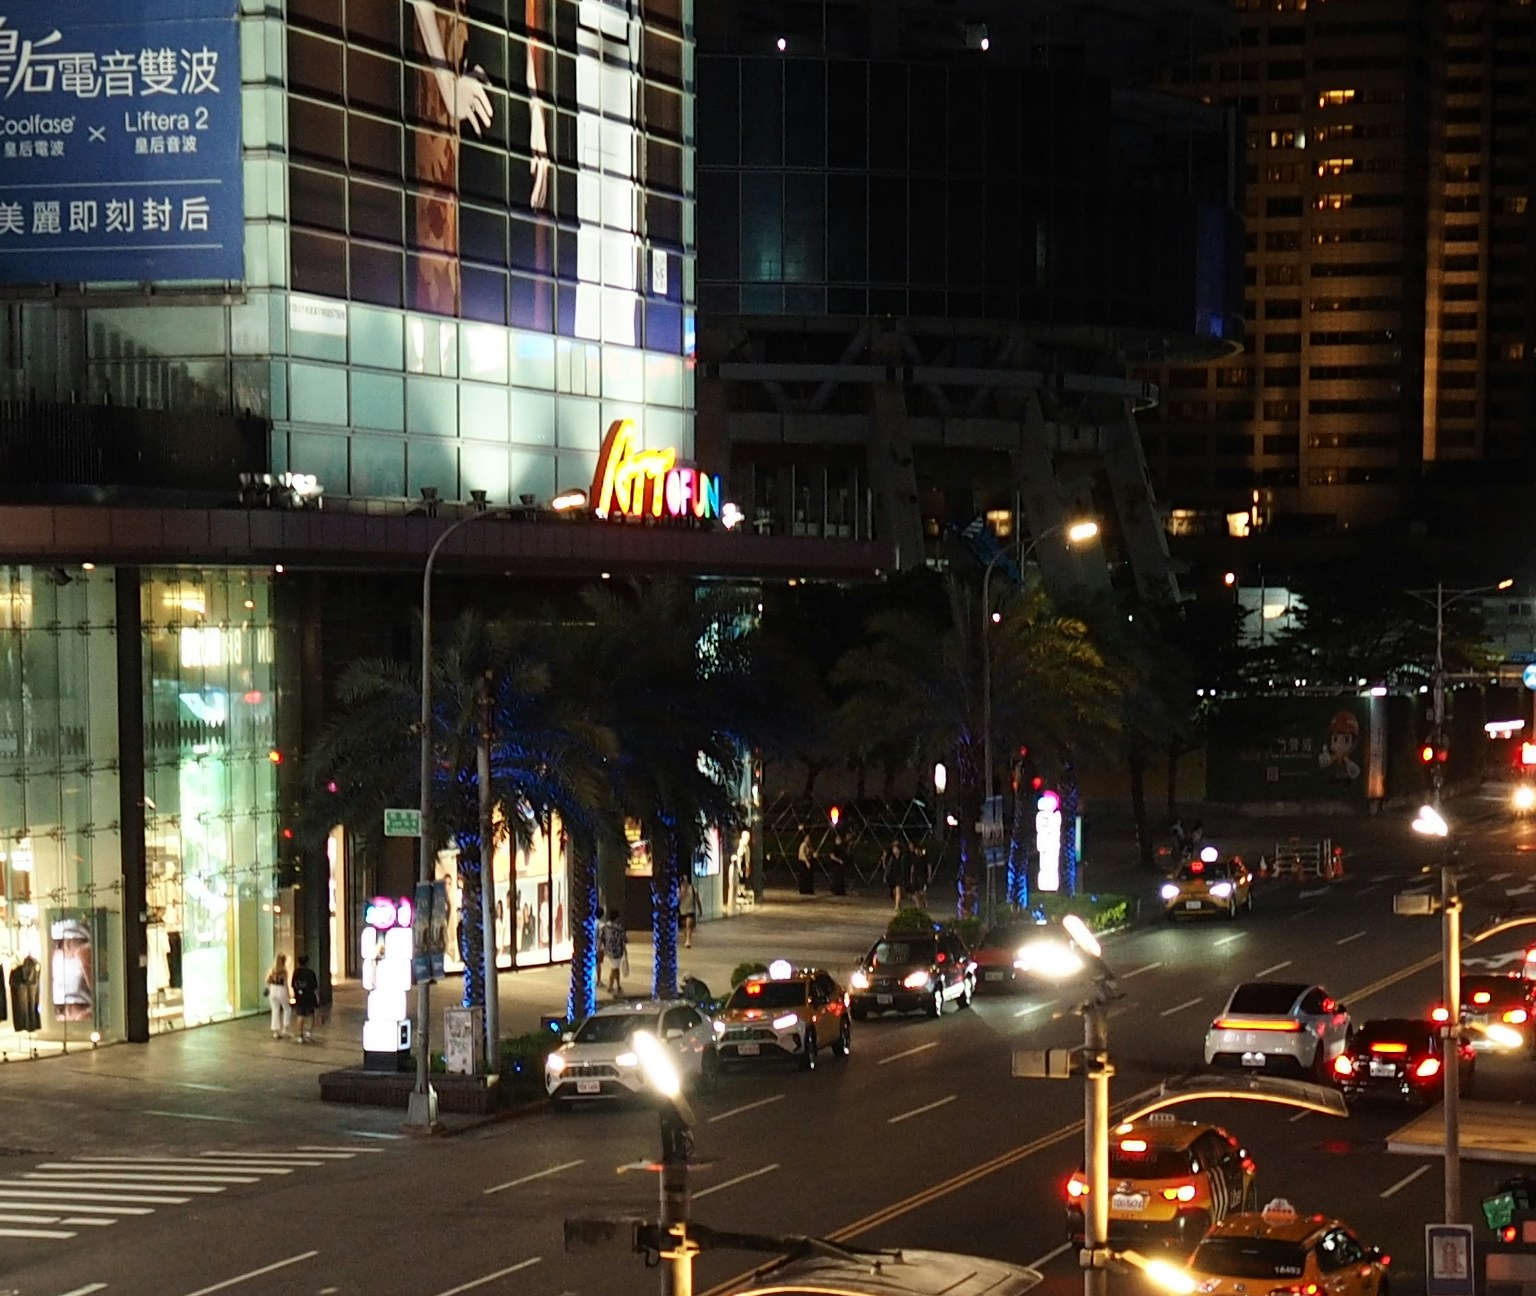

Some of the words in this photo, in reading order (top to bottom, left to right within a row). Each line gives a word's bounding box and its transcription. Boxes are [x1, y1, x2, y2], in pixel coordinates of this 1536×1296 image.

[125, 110, 190, 134] Liftera
[195, 106, 209, 130] 2
[3, 140, 65, 159] 皇后電波
[134, 135, 197, 155] 皇后音波
